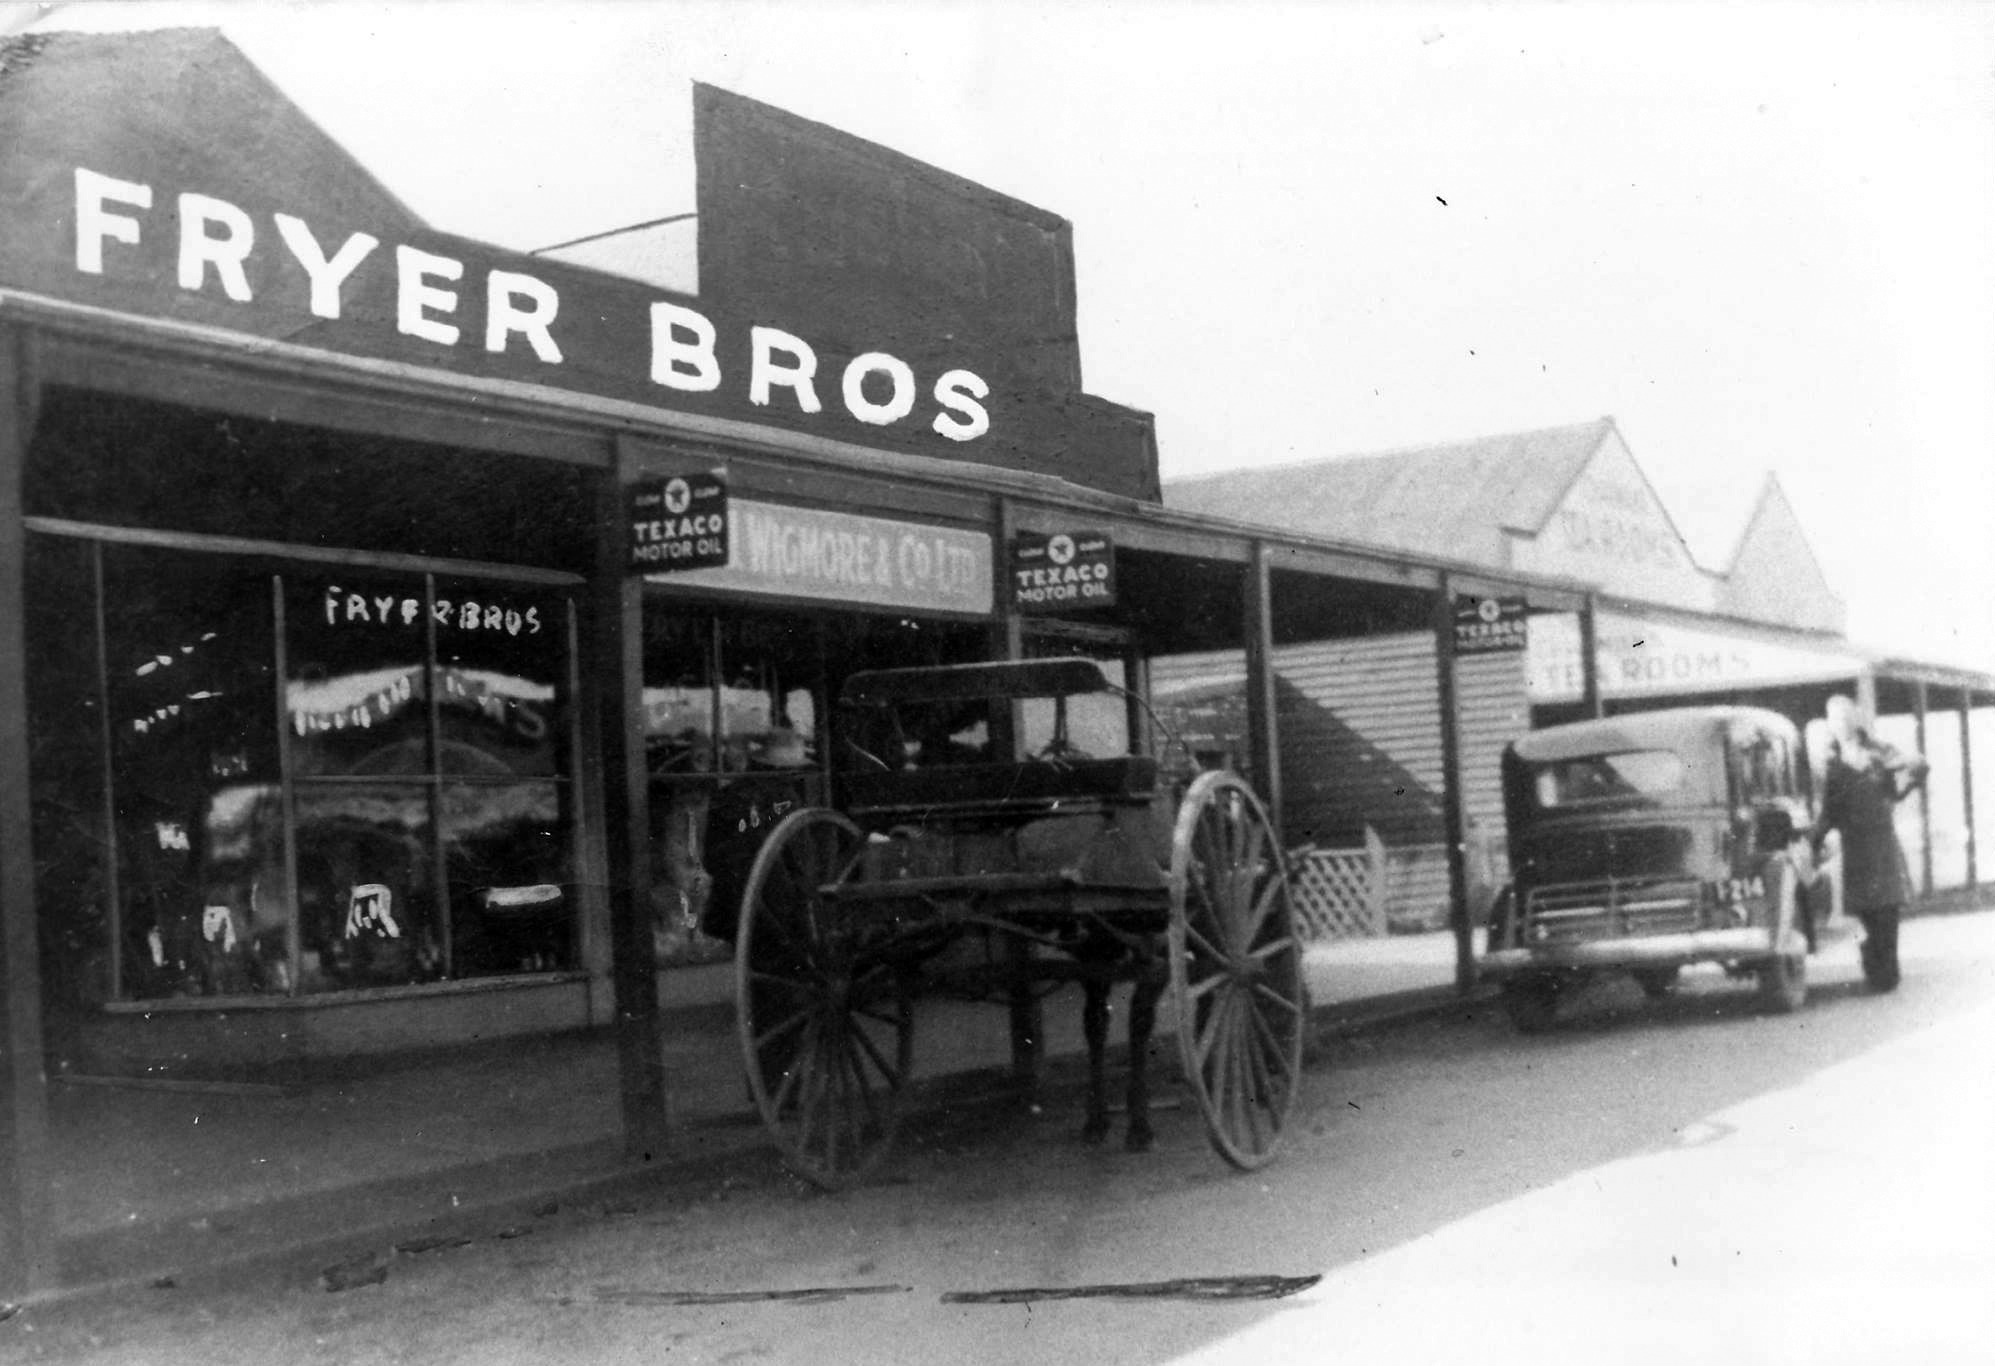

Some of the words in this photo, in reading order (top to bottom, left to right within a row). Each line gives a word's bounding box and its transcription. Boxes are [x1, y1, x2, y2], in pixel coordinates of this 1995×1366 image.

[75, 167, 563, 365] FRYER
[649, 301, 990, 442] BROS
[633, 514, 722, 542] TEXACO
[633, 541, 693, 561] MOTOR
[696, 537, 723, 555] OIL
[1016, 563, 1108, 587] TEXACO
[1016, 584, 1077, 602] MOTOR
[1081, 582, 1109, 597] OIL
[459, 601, 542, 636] BROS
